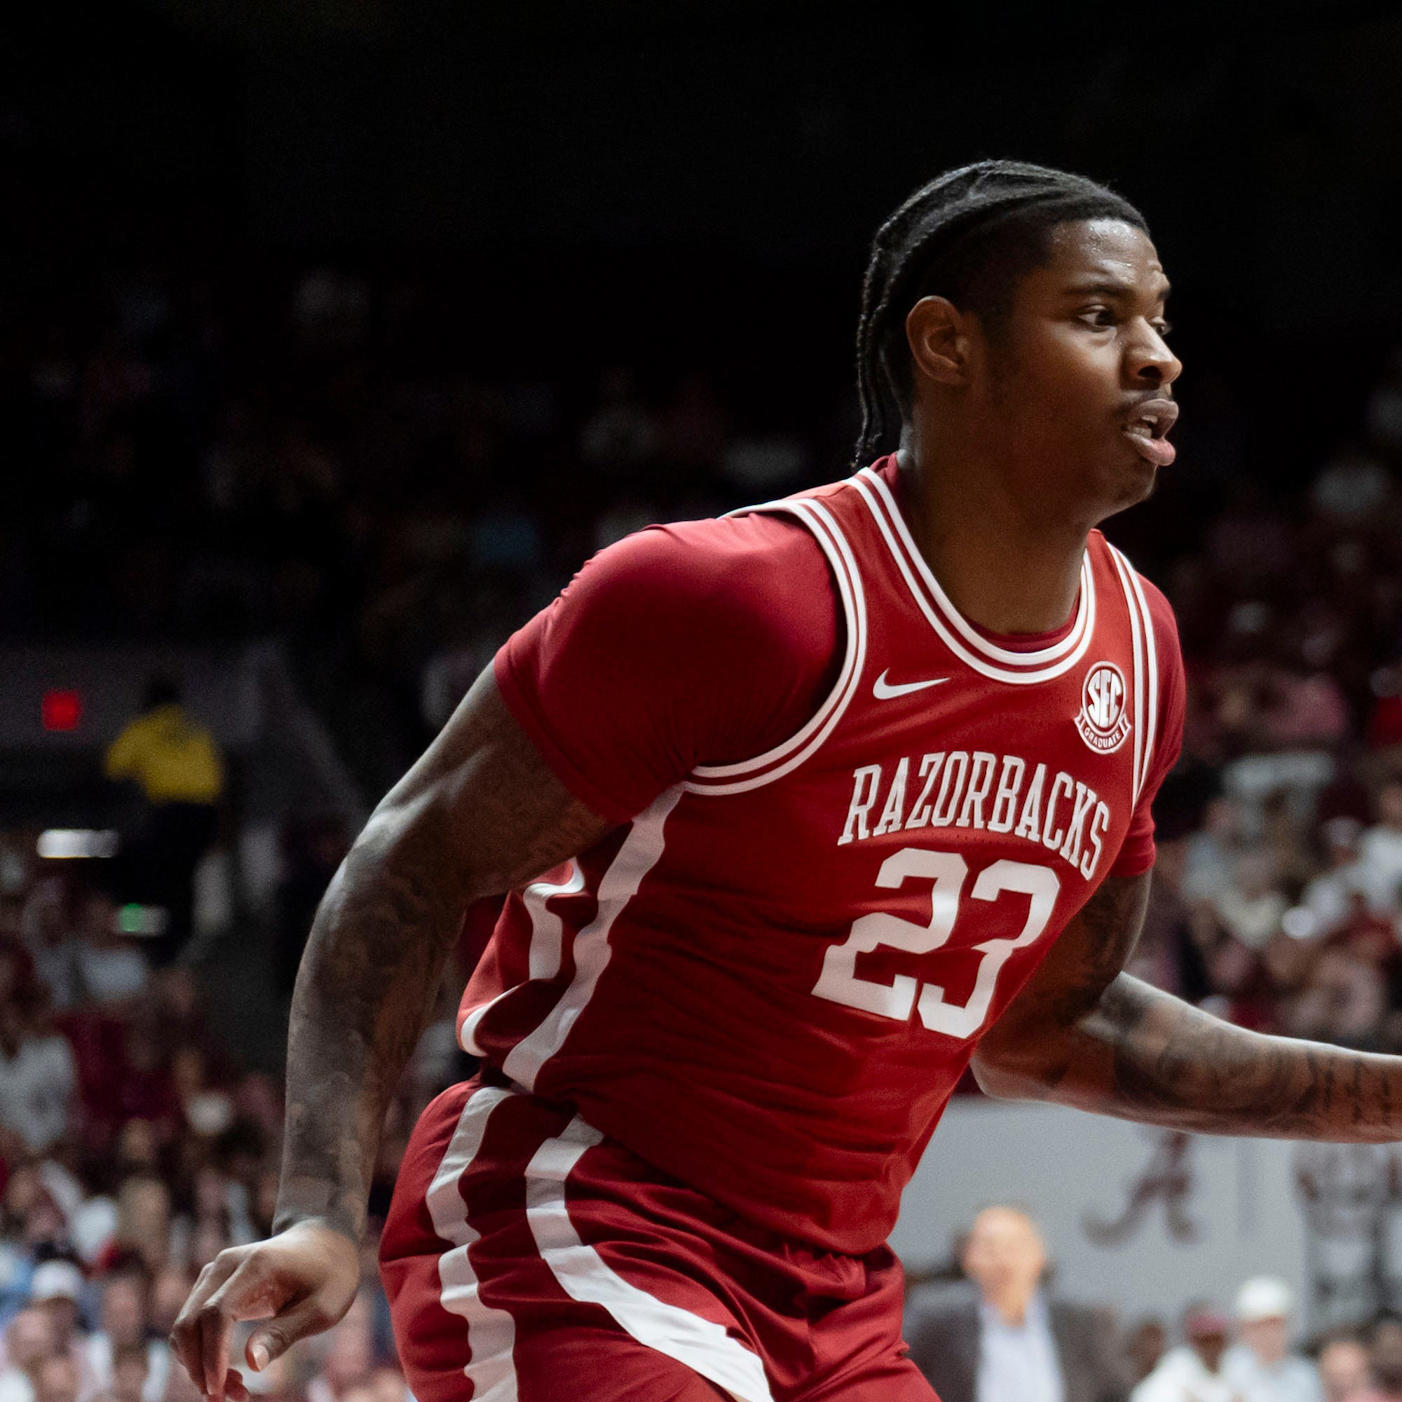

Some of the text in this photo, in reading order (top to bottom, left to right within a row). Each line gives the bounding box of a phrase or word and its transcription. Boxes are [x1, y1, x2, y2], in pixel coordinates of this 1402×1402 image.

[1083, 726, 1121, 749] GRADUATE
[1086, 666, 1123, 730] SEC
[838, 750, 1110, 881] RAZORBACKS
[811, 846, 1061, 1040] 23
